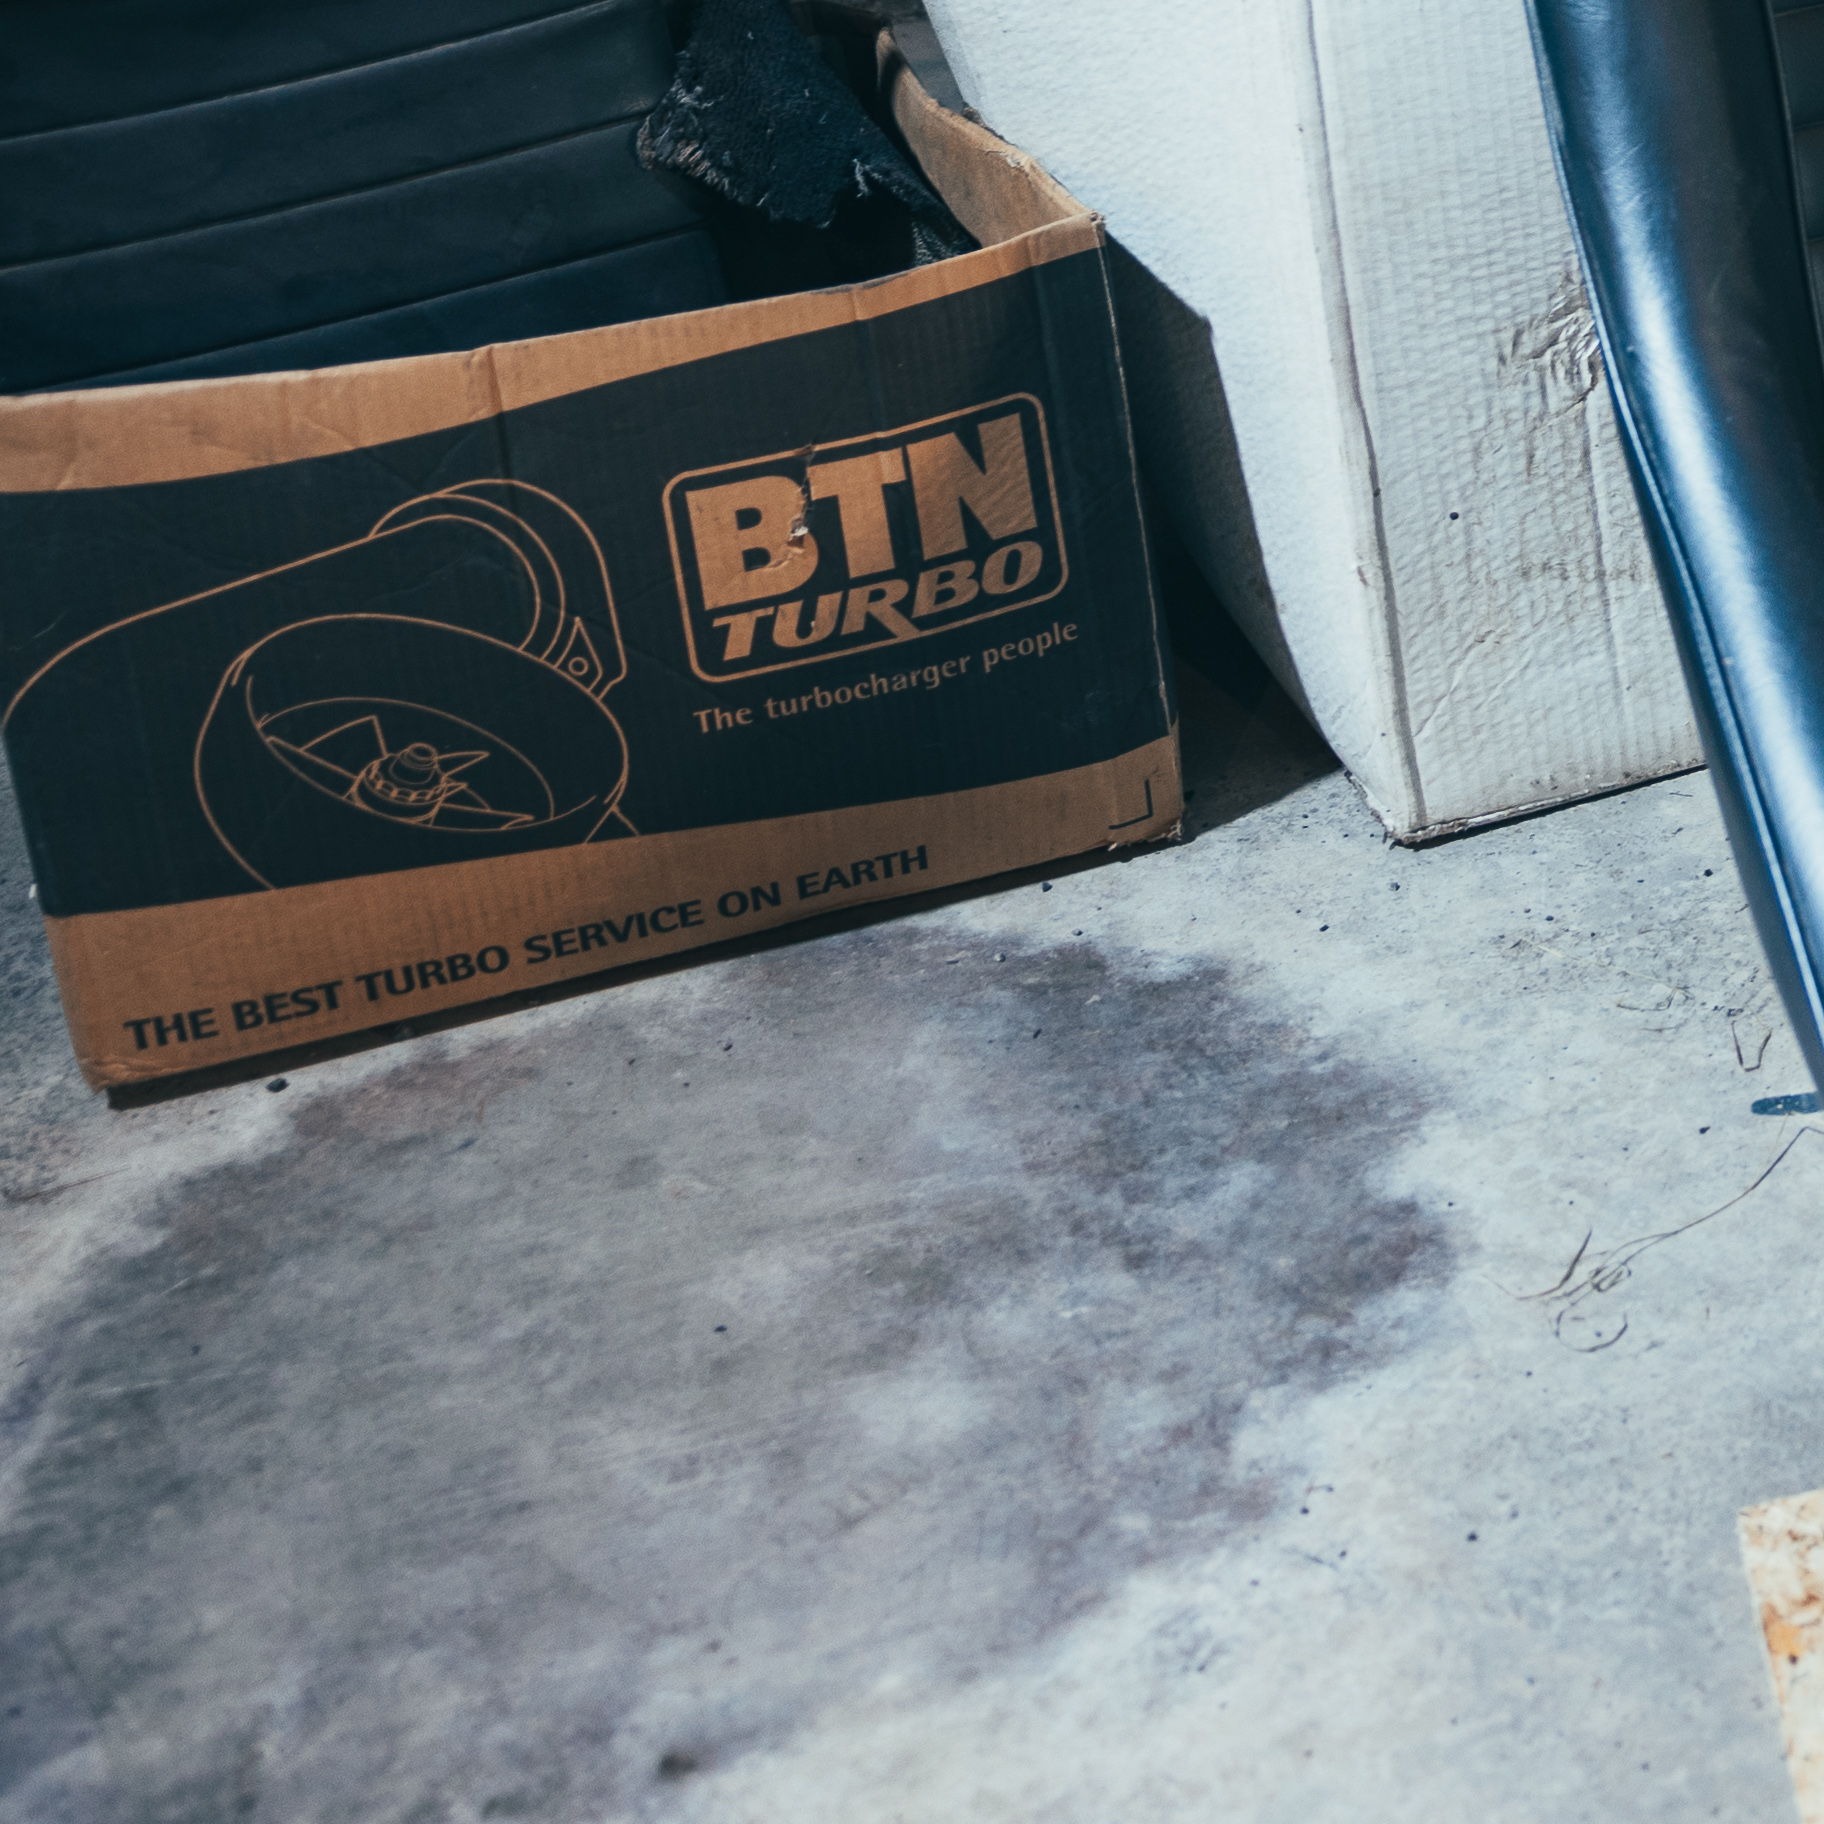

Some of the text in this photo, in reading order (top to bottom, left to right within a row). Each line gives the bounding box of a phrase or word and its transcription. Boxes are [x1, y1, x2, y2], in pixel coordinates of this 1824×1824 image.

[685, 412, 1038, 611] BTN
[692, 622, 1079, 734] The turbocharger people
[711, 541, 1043, 661] TURBO
[124, 845, 929, 1050] THE BEST TURBO SERVICE ON EARTH
